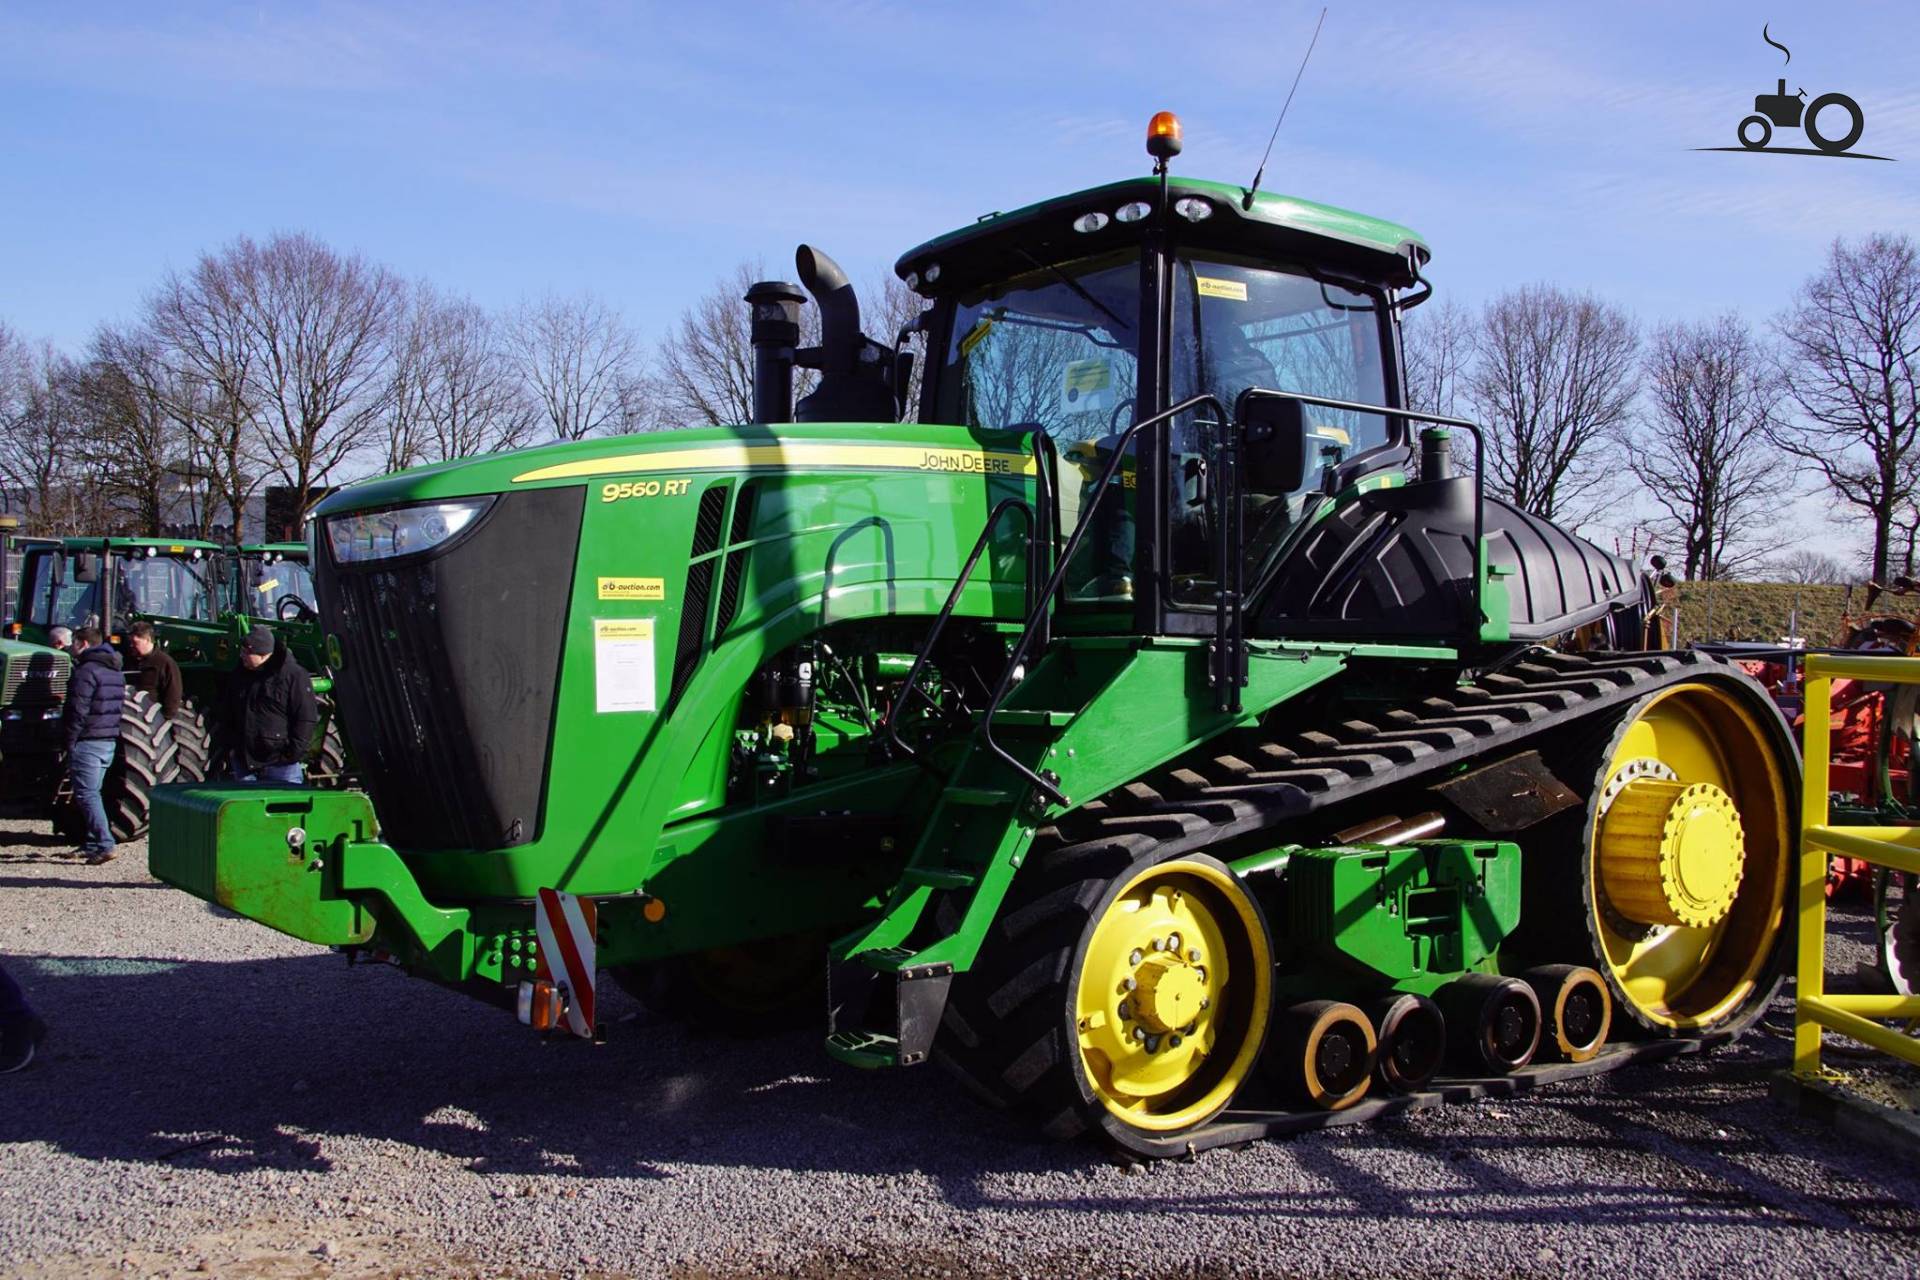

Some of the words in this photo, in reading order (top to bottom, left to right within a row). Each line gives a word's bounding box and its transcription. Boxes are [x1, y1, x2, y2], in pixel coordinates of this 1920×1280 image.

[920, 452, 960, 469] JOHN
[962, 453, 1010, 473] DEERE
[602, 481, 660, 503] 9560
[664, 479, 692, 496] RT
